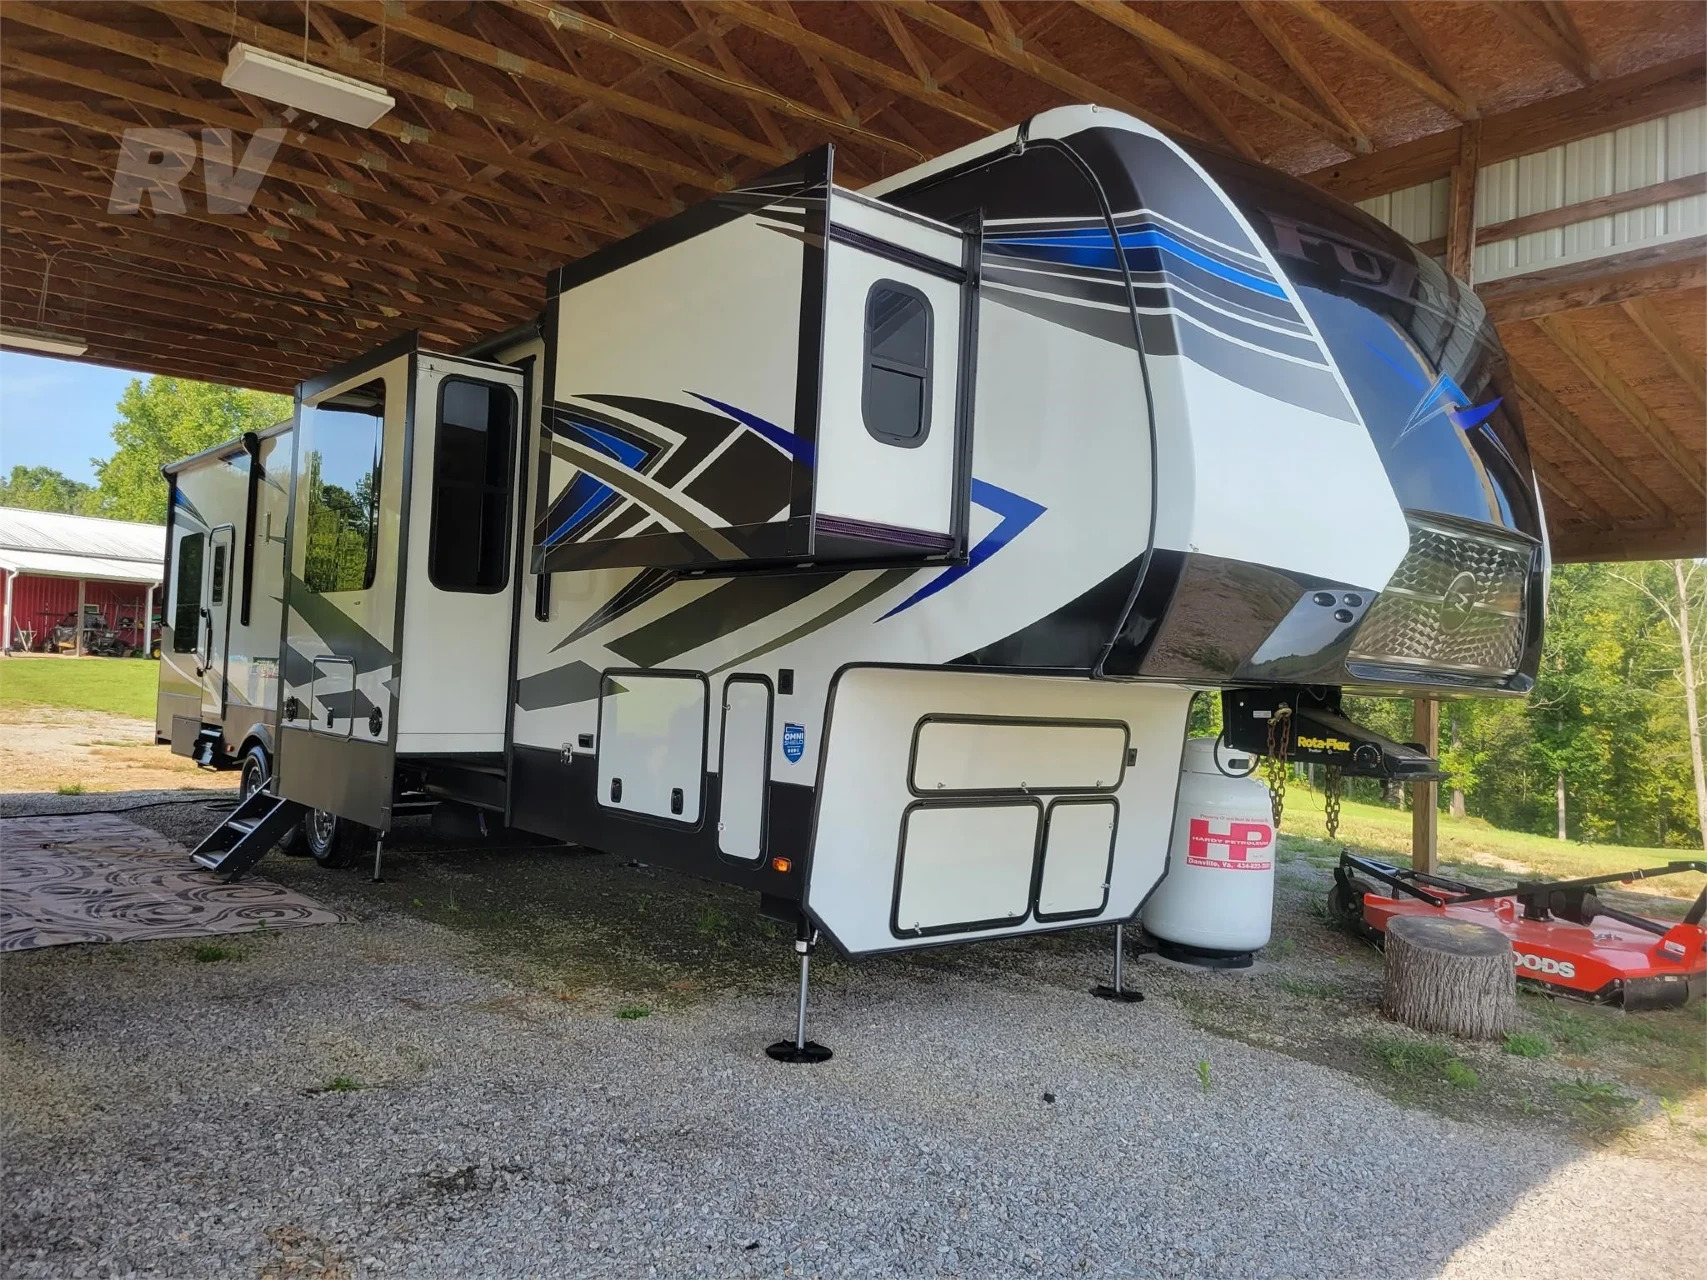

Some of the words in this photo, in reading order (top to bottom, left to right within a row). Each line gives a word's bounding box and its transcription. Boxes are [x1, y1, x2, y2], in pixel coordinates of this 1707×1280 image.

[784, 733, 804, 741] OMNI
[1297, 736, 1351, 751] Rota-Flex
[1188, 818, 1272, 861] HP
[1512, 950, 1575, 978] OODS
